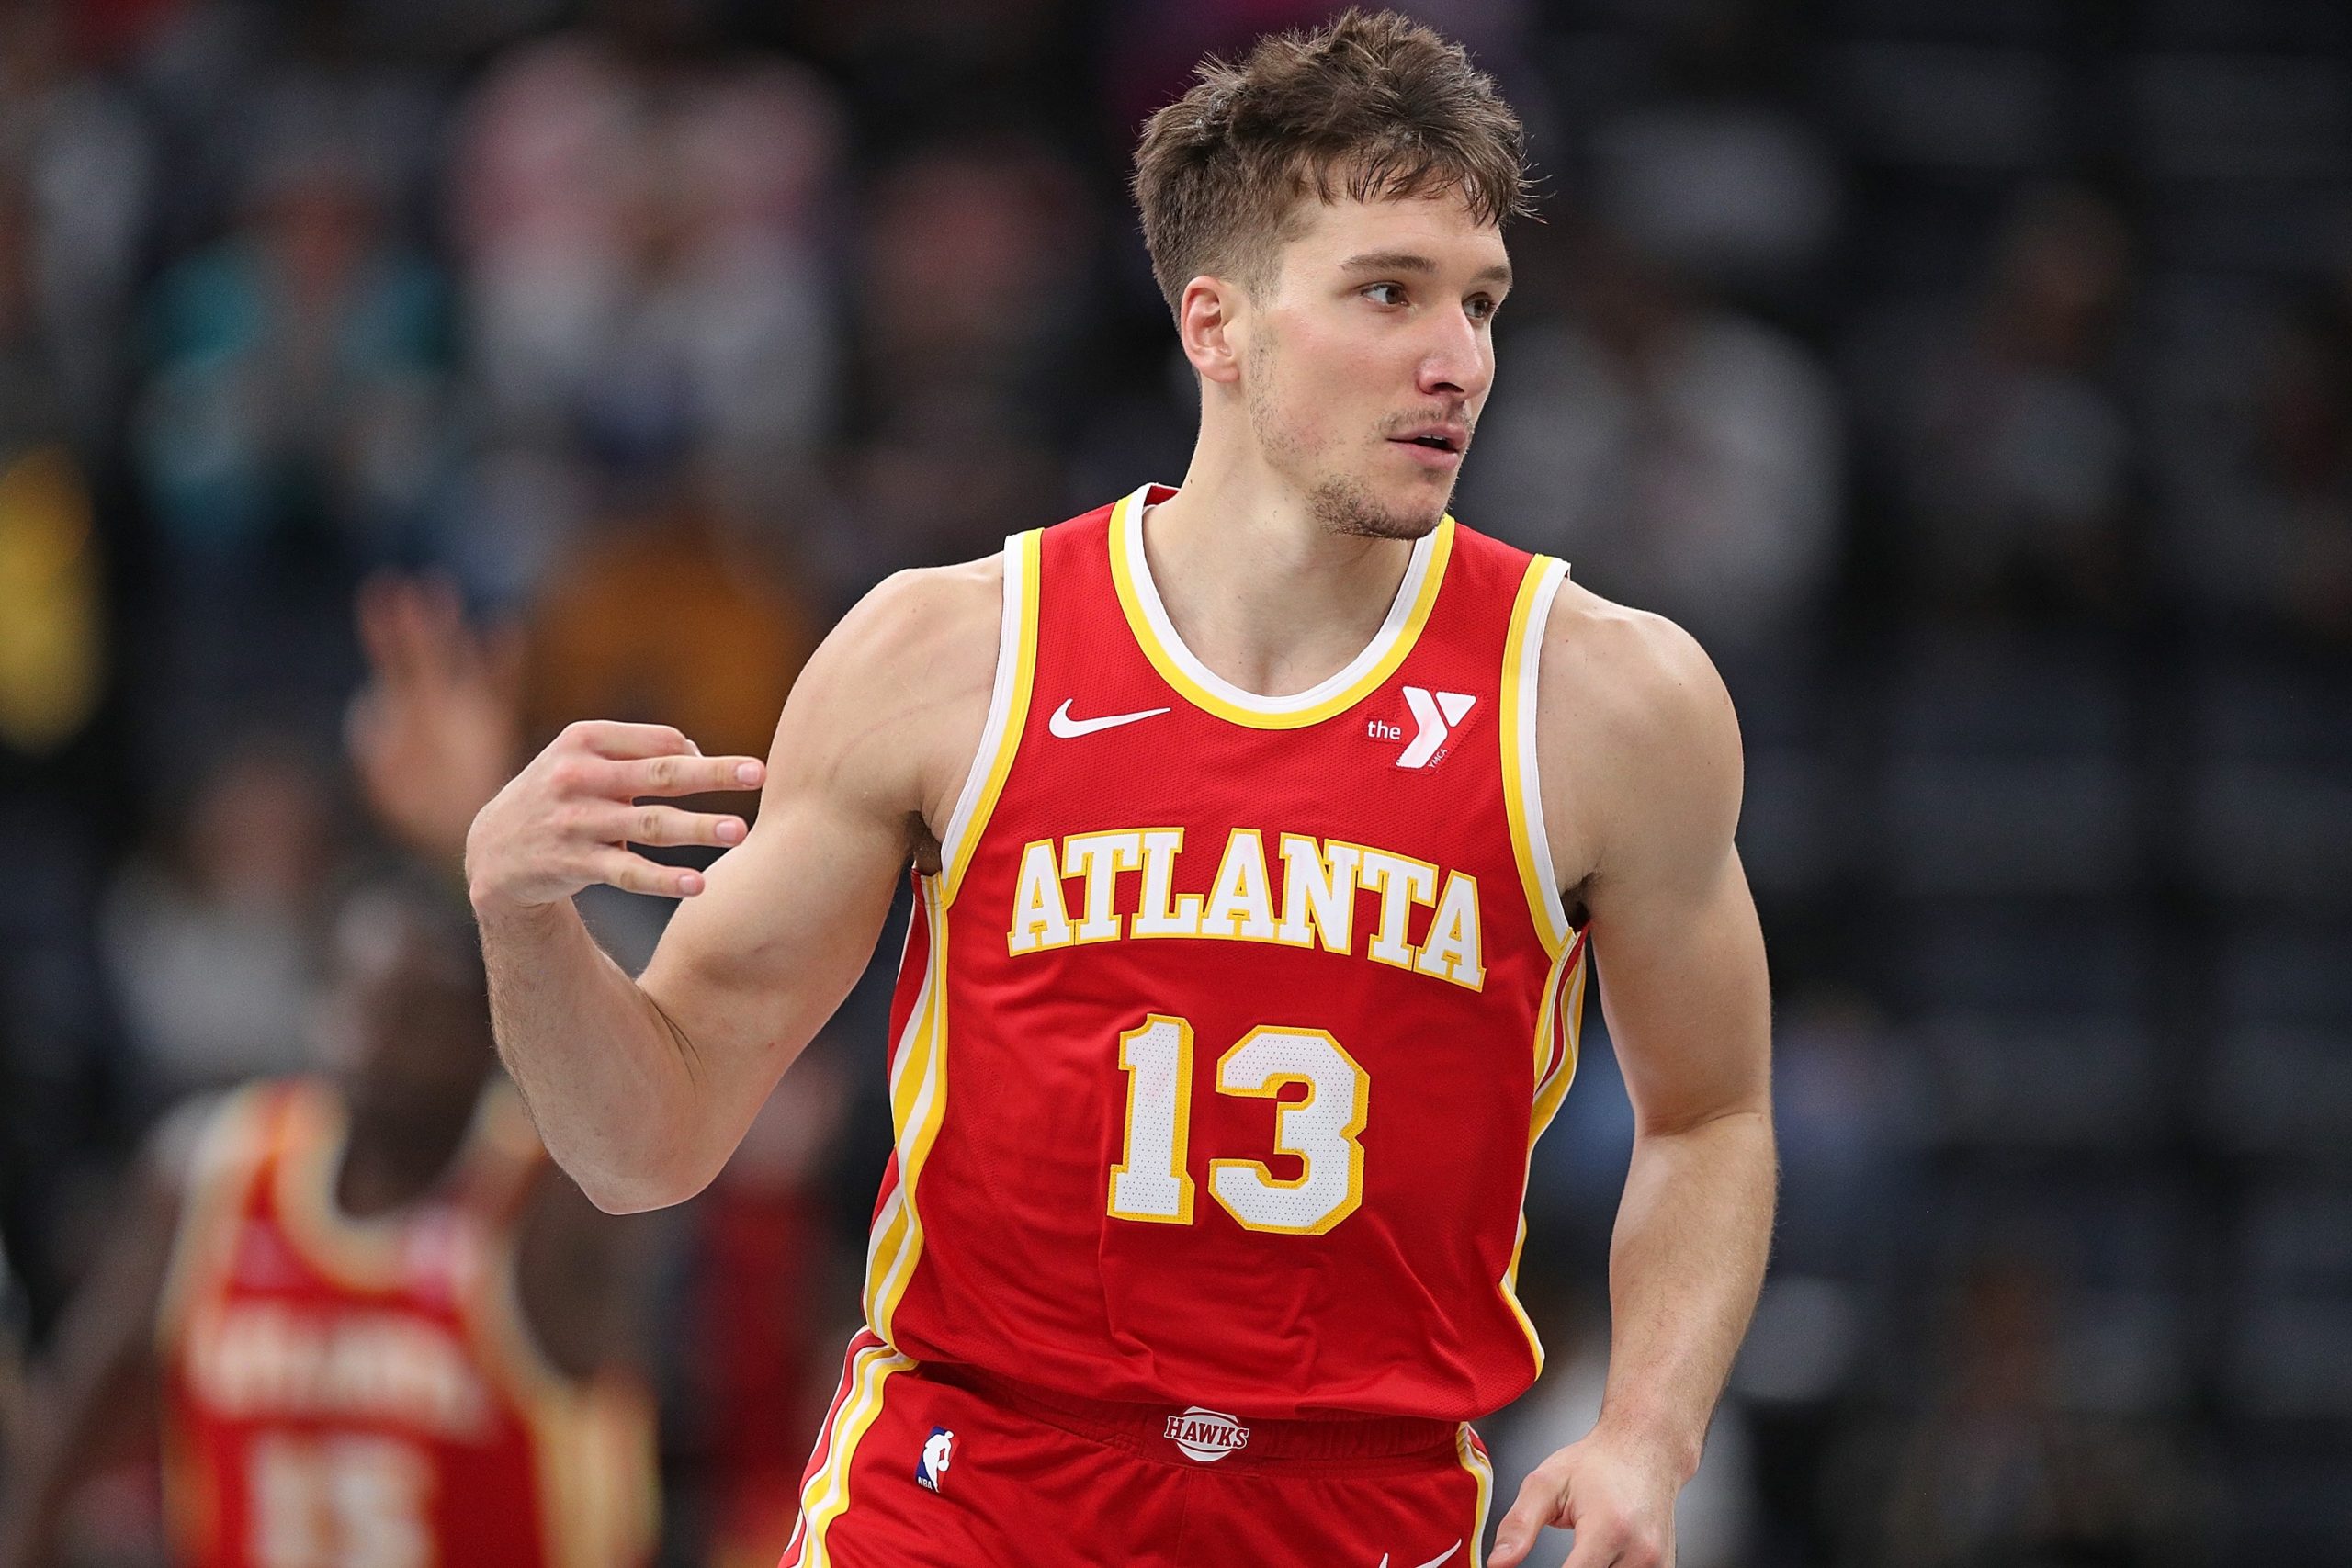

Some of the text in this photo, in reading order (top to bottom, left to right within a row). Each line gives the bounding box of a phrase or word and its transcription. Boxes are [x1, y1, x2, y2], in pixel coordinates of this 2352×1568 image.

[1367, 720, 1402, 740] the
[1427, 748, 1448, 770] YMCA
[1007, 827, 1487, 993] ATLANTA
[1107, 1013, 1371, 1236] 13
[1165, 1416, 1250, 1449] HAWKS
[918, 1475, 933, 1490] NBA
